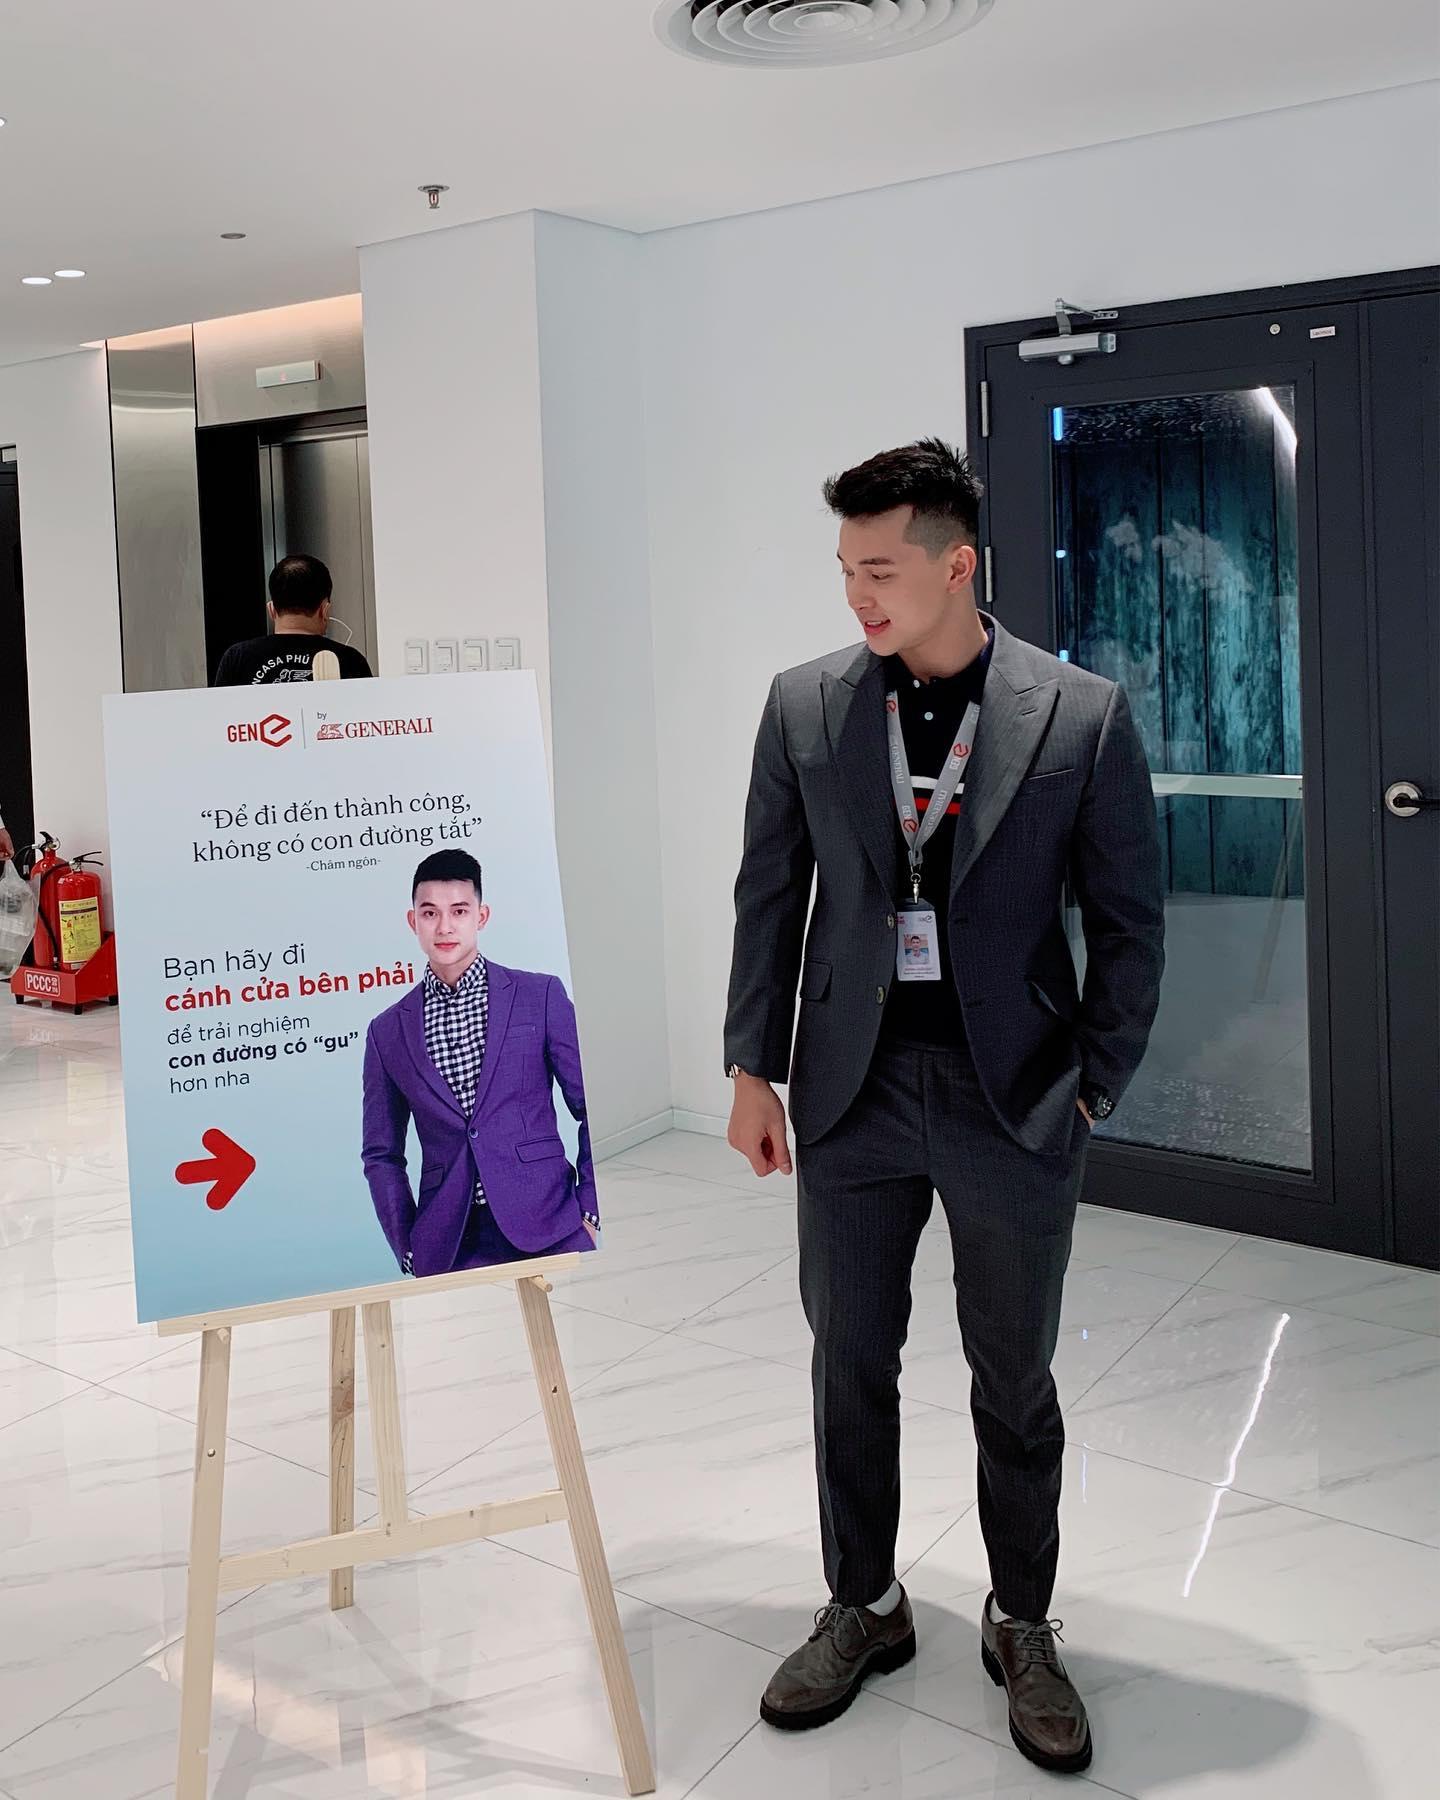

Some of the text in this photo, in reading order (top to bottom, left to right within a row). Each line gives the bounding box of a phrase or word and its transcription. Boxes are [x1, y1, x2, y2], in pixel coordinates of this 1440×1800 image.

[317, 711, 327, 721] by
[345, 717, 433, 739] GENERALI
[201, 792, 471, 829] “Để đi đến thành công,
[192, 815, 482, 862] không có con đường tắt”
[164, 943, 306, 981] Bạn hãy đi
[26, 973, 52, 992] PCCC
[165, 961, 415, 1011] cánh cửa bên phải
[167, 1015, 310, 1045] để trải nghiệm
[169, 1031, 359, 1069] con đường có “gu”
[170, 1070, 250, 1093] hơn nha
